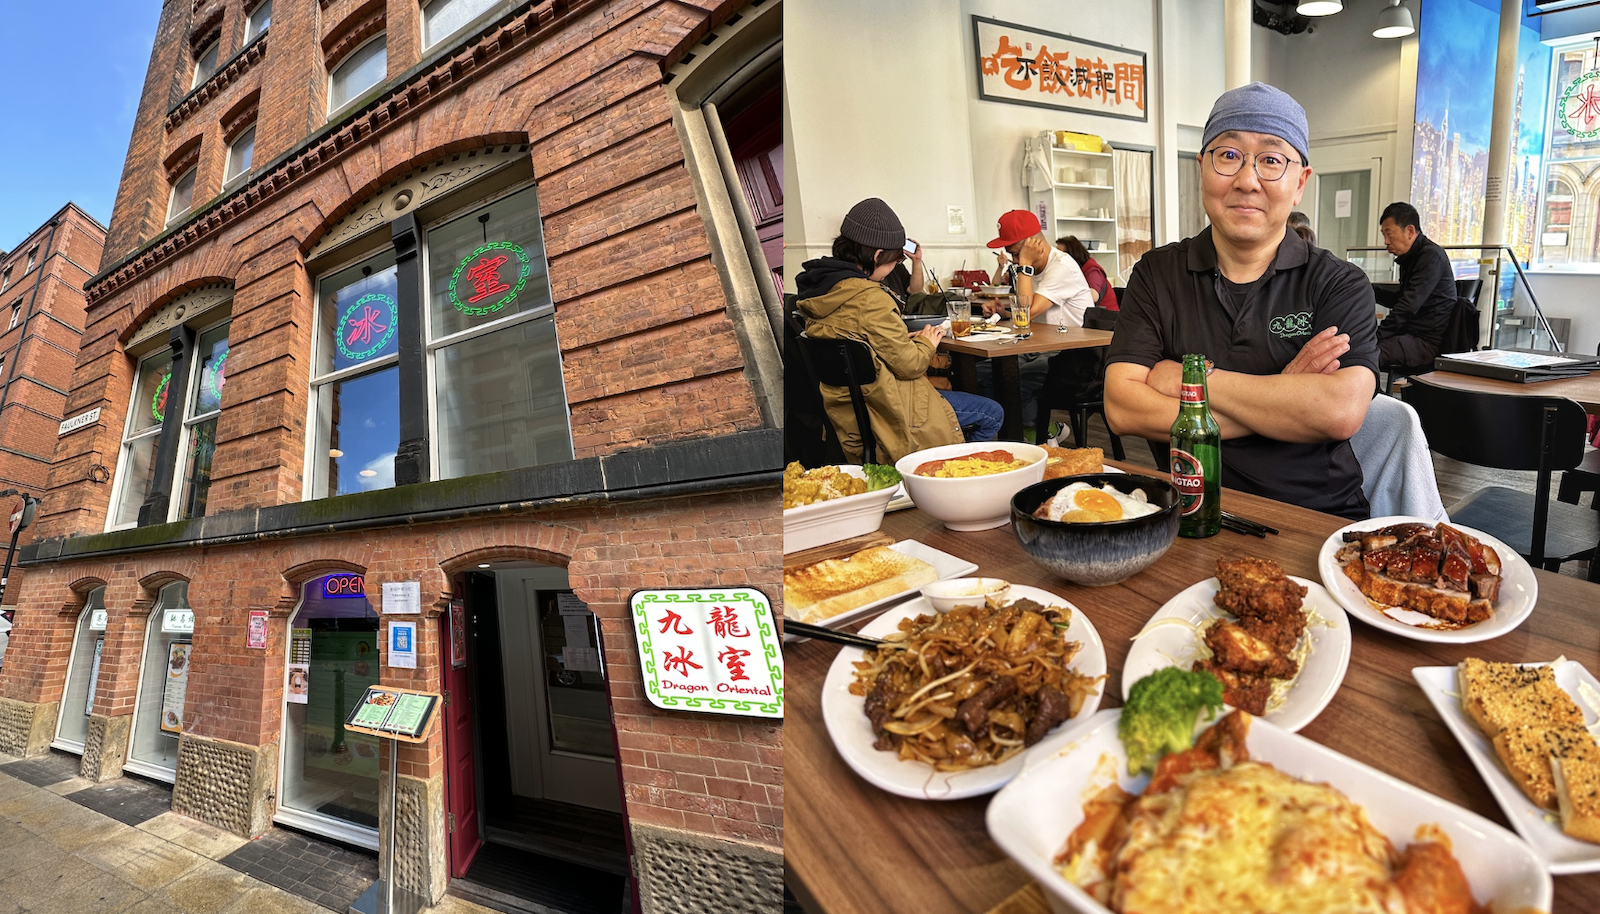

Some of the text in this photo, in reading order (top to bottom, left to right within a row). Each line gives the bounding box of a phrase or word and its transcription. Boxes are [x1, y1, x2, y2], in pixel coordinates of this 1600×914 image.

[466, 255, 511, 303] 室
[348, 306, 387, 345] 冰
[657, 605, 751, 639] 九龍
[662, 645, 751, 682] 冰室
[662, 680, 772, 696] Dragon Oriental
